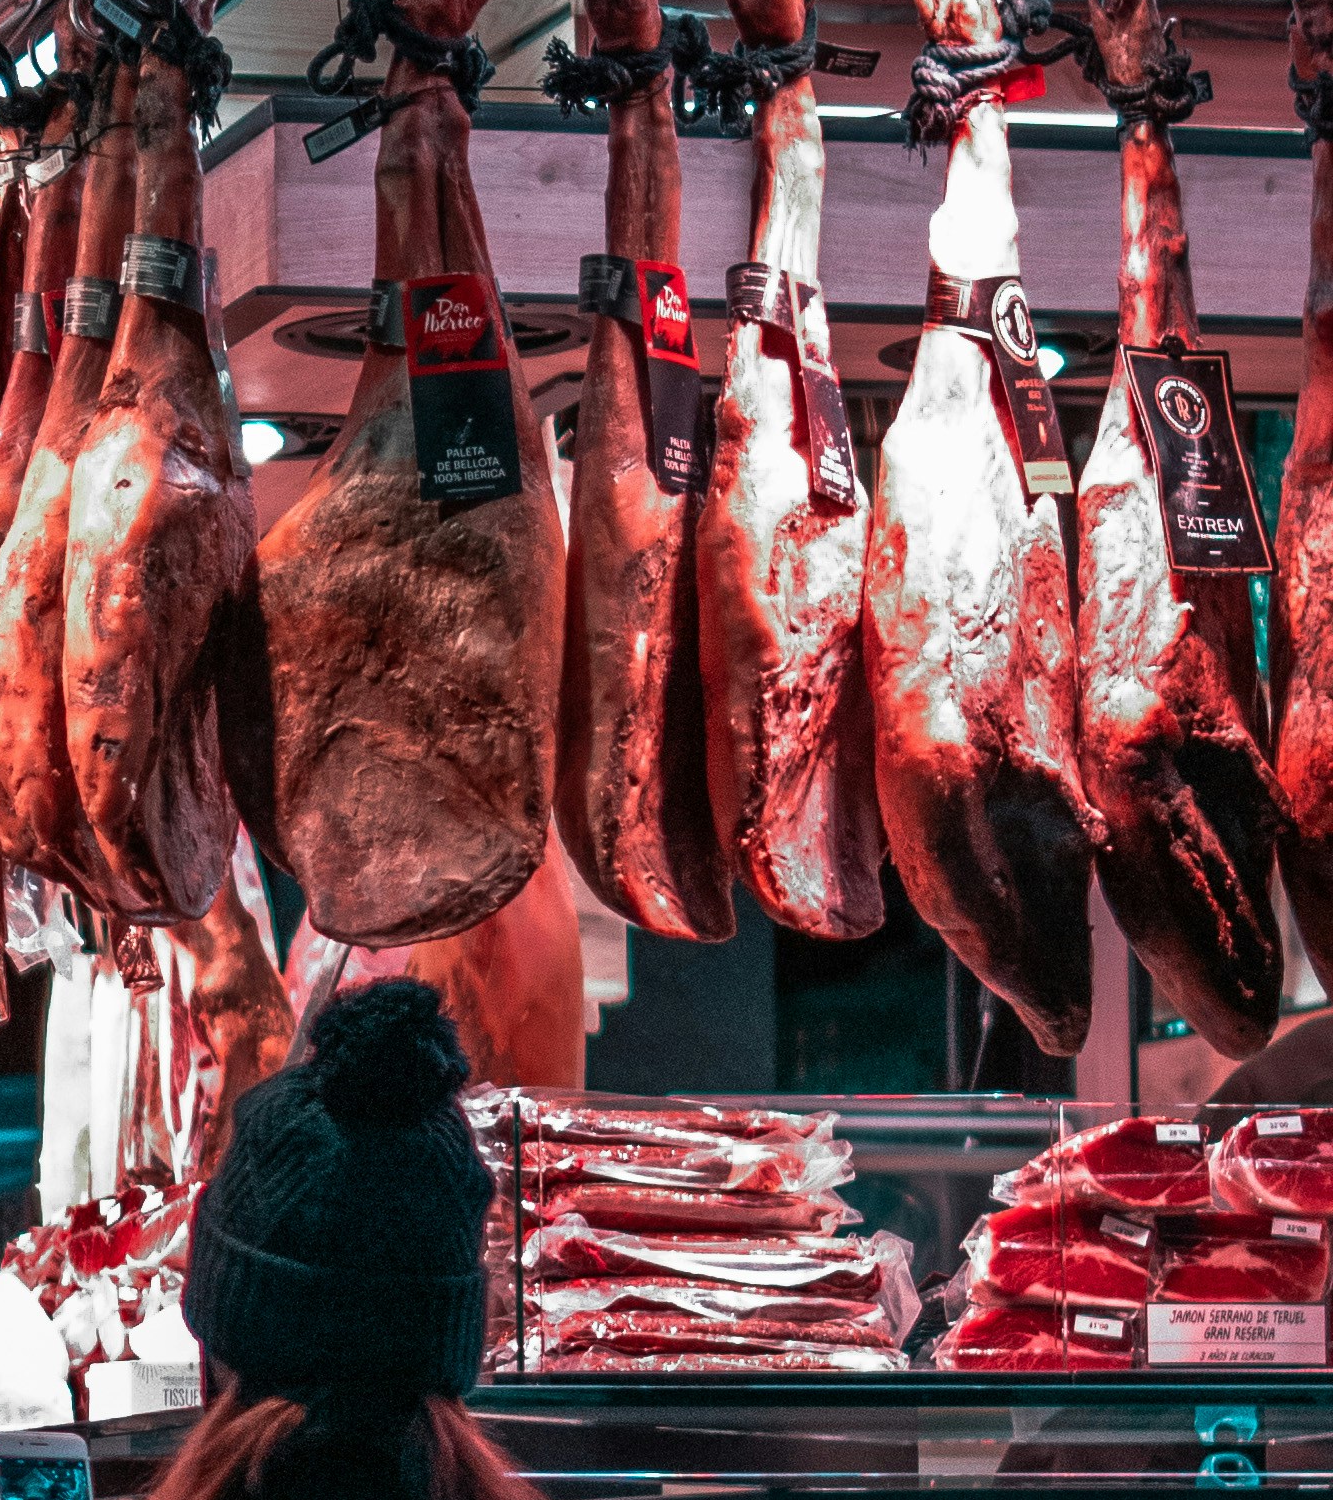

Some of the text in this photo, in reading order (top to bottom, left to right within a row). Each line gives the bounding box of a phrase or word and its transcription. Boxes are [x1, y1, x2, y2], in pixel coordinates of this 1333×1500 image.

[436, 297, 469, 316] Don
[446, 446, 486, 459] PALETA
[436, 456, 500, 472] DE BELLOTA
[433, 472, 463, 484] 100%
[1177, 514, 1244, 532] EXTREM
[1169, 1309, 1308, 1324] JAMON SERRANO DE TERUEL
[1204, 1327, 1276, 1340] GRAN RESERVA
